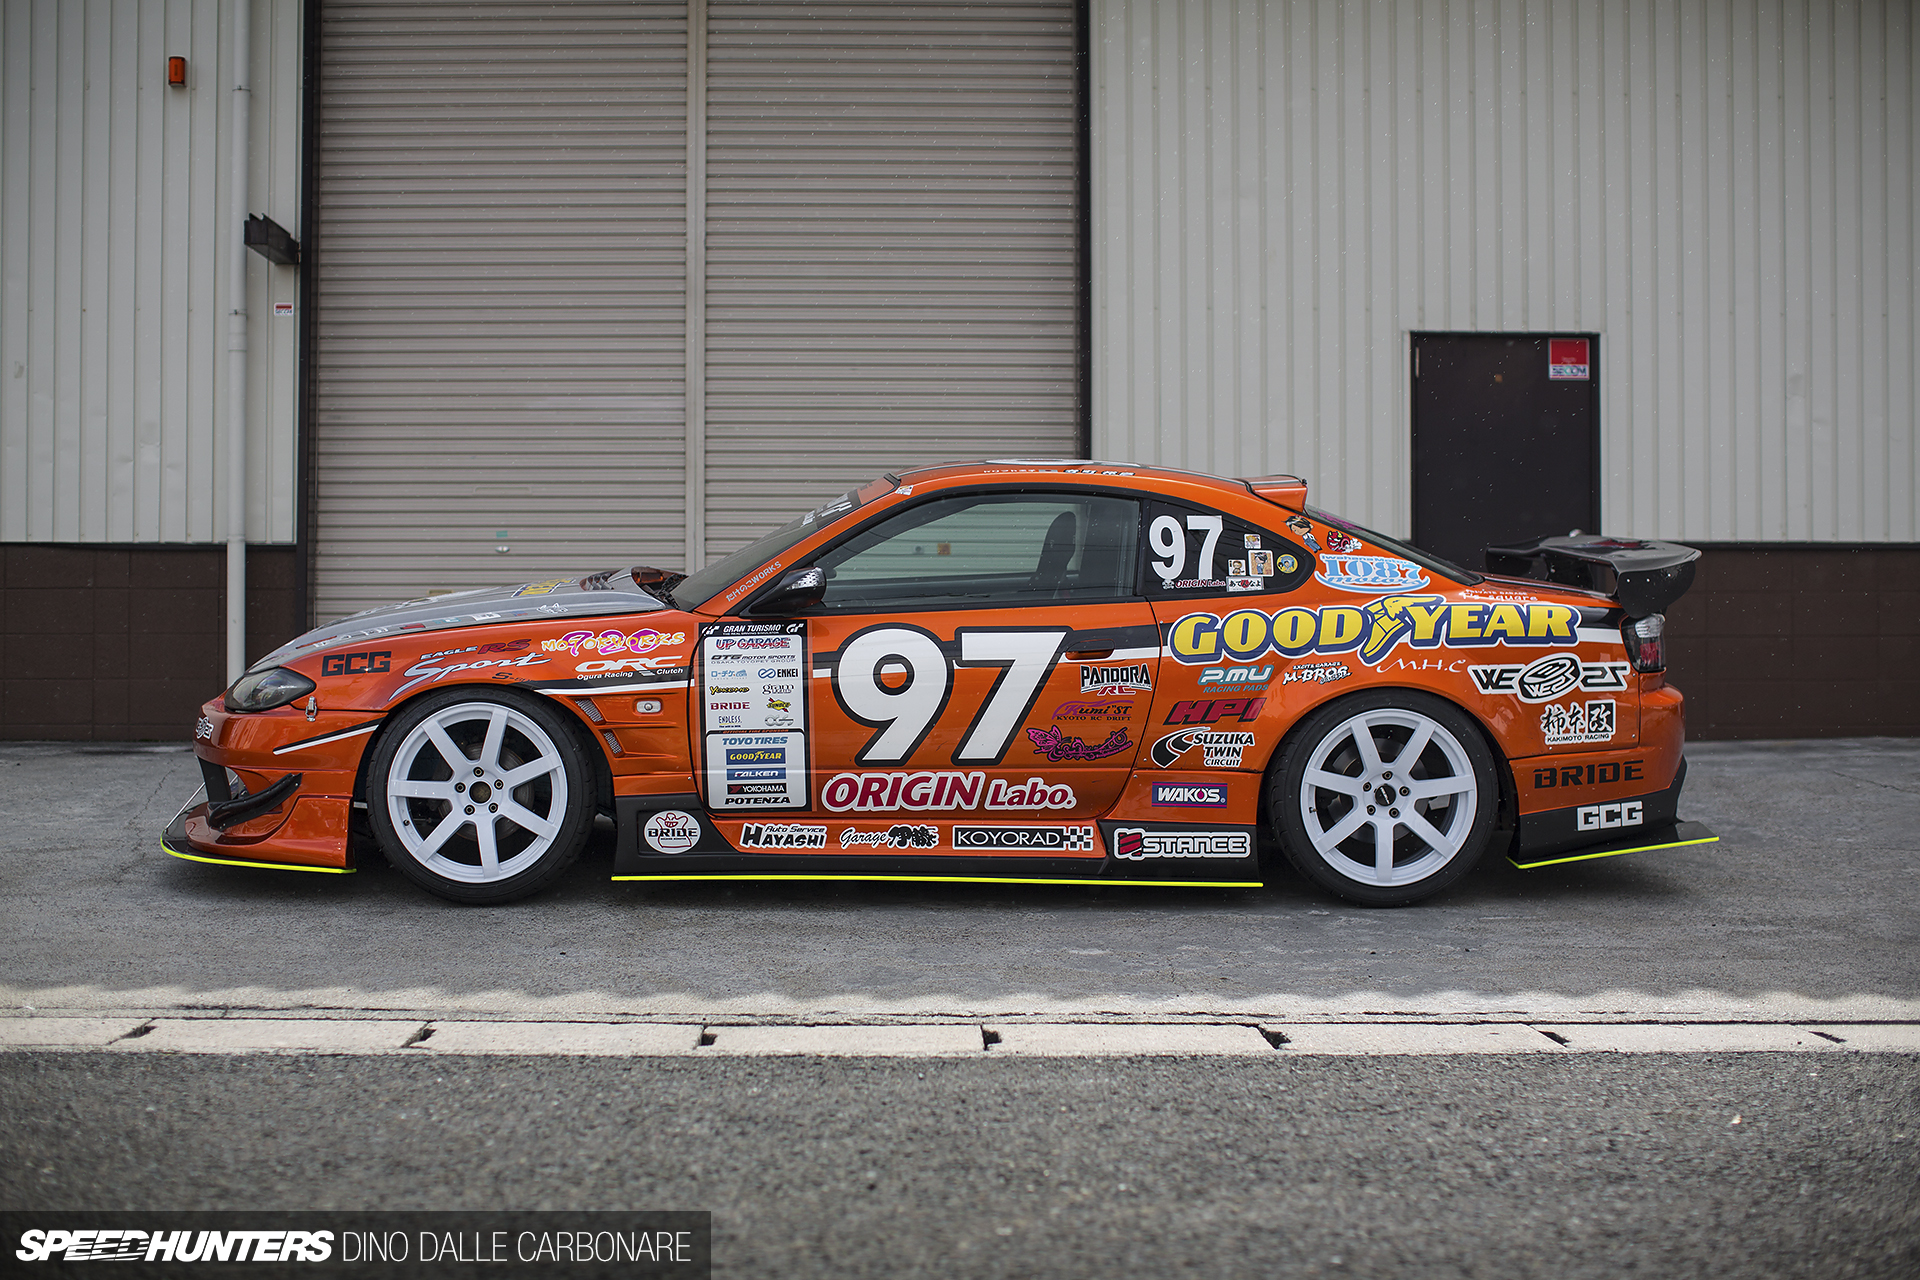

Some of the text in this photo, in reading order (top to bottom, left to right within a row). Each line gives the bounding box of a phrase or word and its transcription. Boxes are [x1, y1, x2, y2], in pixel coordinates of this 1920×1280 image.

[1552, 365, 1587, 377] SECOM
[1149, 515, 1223, 580] 97
[1325, 559, 1422, 579] 1087
[1175, 579, 1208, 589] ORIGIN
[723, 624, 781, 633] GRAN TURISMO
[541, 632, 685, 652] MOTORWORKS
[715, 637, 791, 650] UP GARAGE
[420, 639, 532, 661] EAGLE RS
[322, 651, 391, 677] GCG
[575, 656, 683, 674] ORC
[388, 652, 552, 701] Sport
[604, 671, 634, 679] Racing
[777, 668, 798, 678] ENKEI
[1080, 663, 1152, 688] PANDORA
[709, 686, 750, 696] YOKOMO
[834, 625, 1070, 764] 97
[1097, 685, 1136, 696] RC
[1203, 683, 1270, 693] RACING PADS
[710, 701, 750, 710] BRIDE
[1163, 697, 1267, 725] HPI
[718, 715, 741, 724] ENDLESS
[1193, 733, 1255, 746] SUZUKA
[1547, 735, 1582, 743] KAKIMOTO
[1204, 746, 1243, 758] TWIN
[1204, 758, 1242, 767] CIRCUIT
[734, 770, 778, 778] FALKEN
[1533, 759, 1644, 790] BRIDE
[742, 785, 785, 793] YOKOHAMA
[823, 773, 1075, 810] ORIGIN Labo.
[724, 796, 791, 805] POTENZA
[1577, 801, 1643, 831] GCG
[647, 828, 698, 837] BRIDE
[765, 825, 825, 833] Auto Service
[742, 826, 825, 847] HAYASHI
[840, 828, 886, 848] Garage
[957, 830, 1061, 846] KOYORAD
[1142, 834, 1247, 855] STANCE
